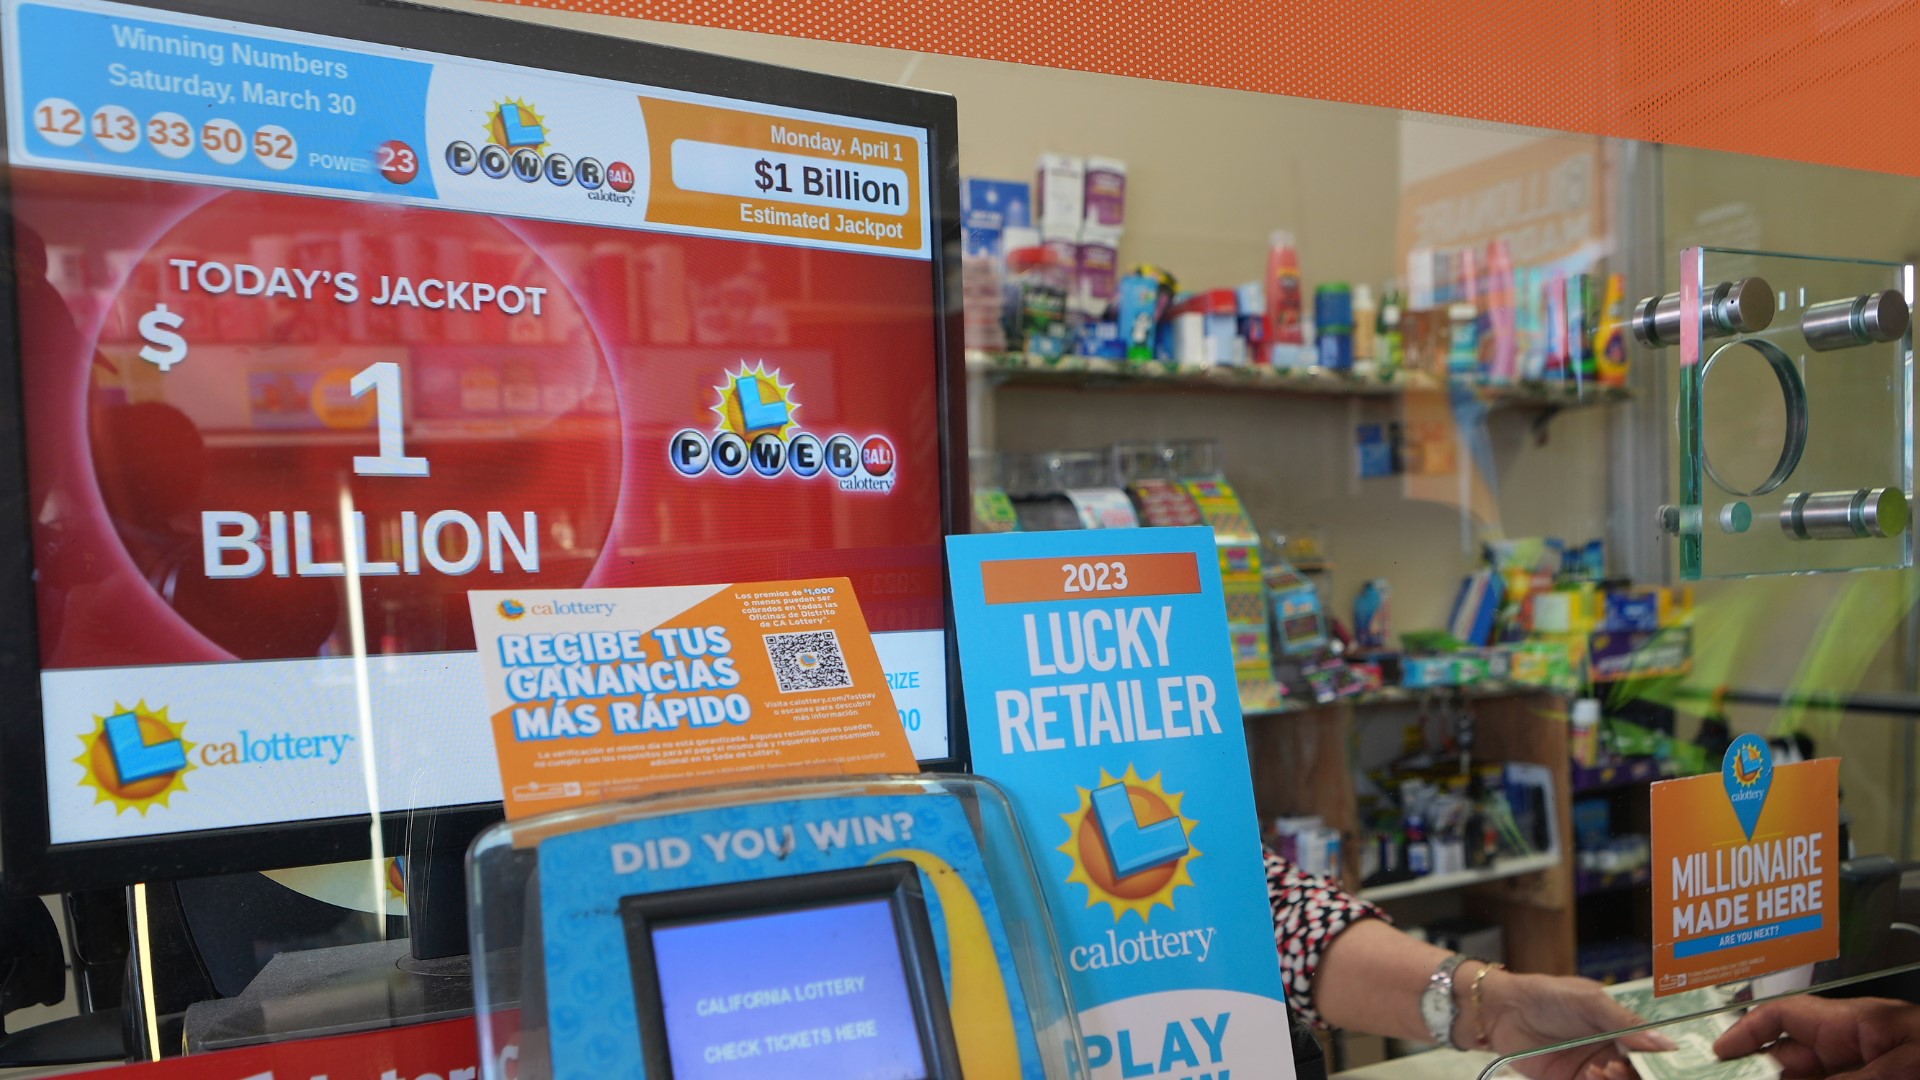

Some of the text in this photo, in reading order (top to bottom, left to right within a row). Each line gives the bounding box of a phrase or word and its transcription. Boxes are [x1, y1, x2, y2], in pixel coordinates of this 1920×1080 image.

[112, 24, 349, 80] Winning Numbers
[108, 63, 356, 116] Saturday, March 30
[37, 105, 83, 136] 12
[93, 111, 137, 142] 13
[148, 119, 191, 148] 33
[202, 125, 243, 154] 50
[253, 131, 294, 160] 52
[378, 146, 415, 173] 23
[771, 124, 902, 162] Monday, April 1
[587, 189, 634, 207] calottery
[754, 158, 902, 206] $1 Billion
[740, 203, 903, 240] Estimated Jackpot
[371, 276, 547, 316] JACKPOT
[138, 303, 188, 371] $
[350, 361, 430, 478] 1
[840, 475, 893, 494] calottery
[201, 510, 540, 578] BILLION
[754, 590, 790, 600] premios
[803, 587, 835, 596] $1,000
[1061, 561, 1128, 594] 2023
[531, 600, 616, 616] calottery
[741, 605, 782, 614] cobrados
[798, 602, 822, 610] todas
[749, 612, 786, 621] Oficinas
[801, 609, 836, 617] Distrito
[752, 598, 781, 606] menos
[783, 596, 815, 604] pueden
[499, 625, 732, 667] RECIBE TUS
[1023, 605, 1172, 677] LUCKY
[885, 671, 920, 690] RIZE
[513, 693, 751, 741] MÁS RÁPIDO
[764, 700, 788, 709] Visita
[781, 706, 814, 715] escanea
[815, 704, 834, 712] para
[835, 700, 872, 710] descubrir
[811, 709, 859, 720] información
[995, 675, 1222, 755] RETAILER
[201, 729, 354, 767] calottery
[750, 732, 783, 741] Algunas
[784, 726, 842, 738] reclamaciones
[843, 722, 873, 733] pueden
[821, 730, 880, 743] procesamiento
[1731, 788, 1764, 802] calottery
[611, 812, 915, 875] DID YOU WIN?
[1672, 832, 1823, 901] MILLIONAIRE
[1672, 879, 1823, 938] MADE HERE
[1070, 927, 1216, 972] calottery
[1719, 925, 1780, 947] ARE YOU NEXT?
[696, 975, 866, 1018] CALIFORNIA LOTTERY
[704, 1019, 878, 1065] CHECK TICKETS HERE
[1064, 1012, 1231, 1080] PLAY
